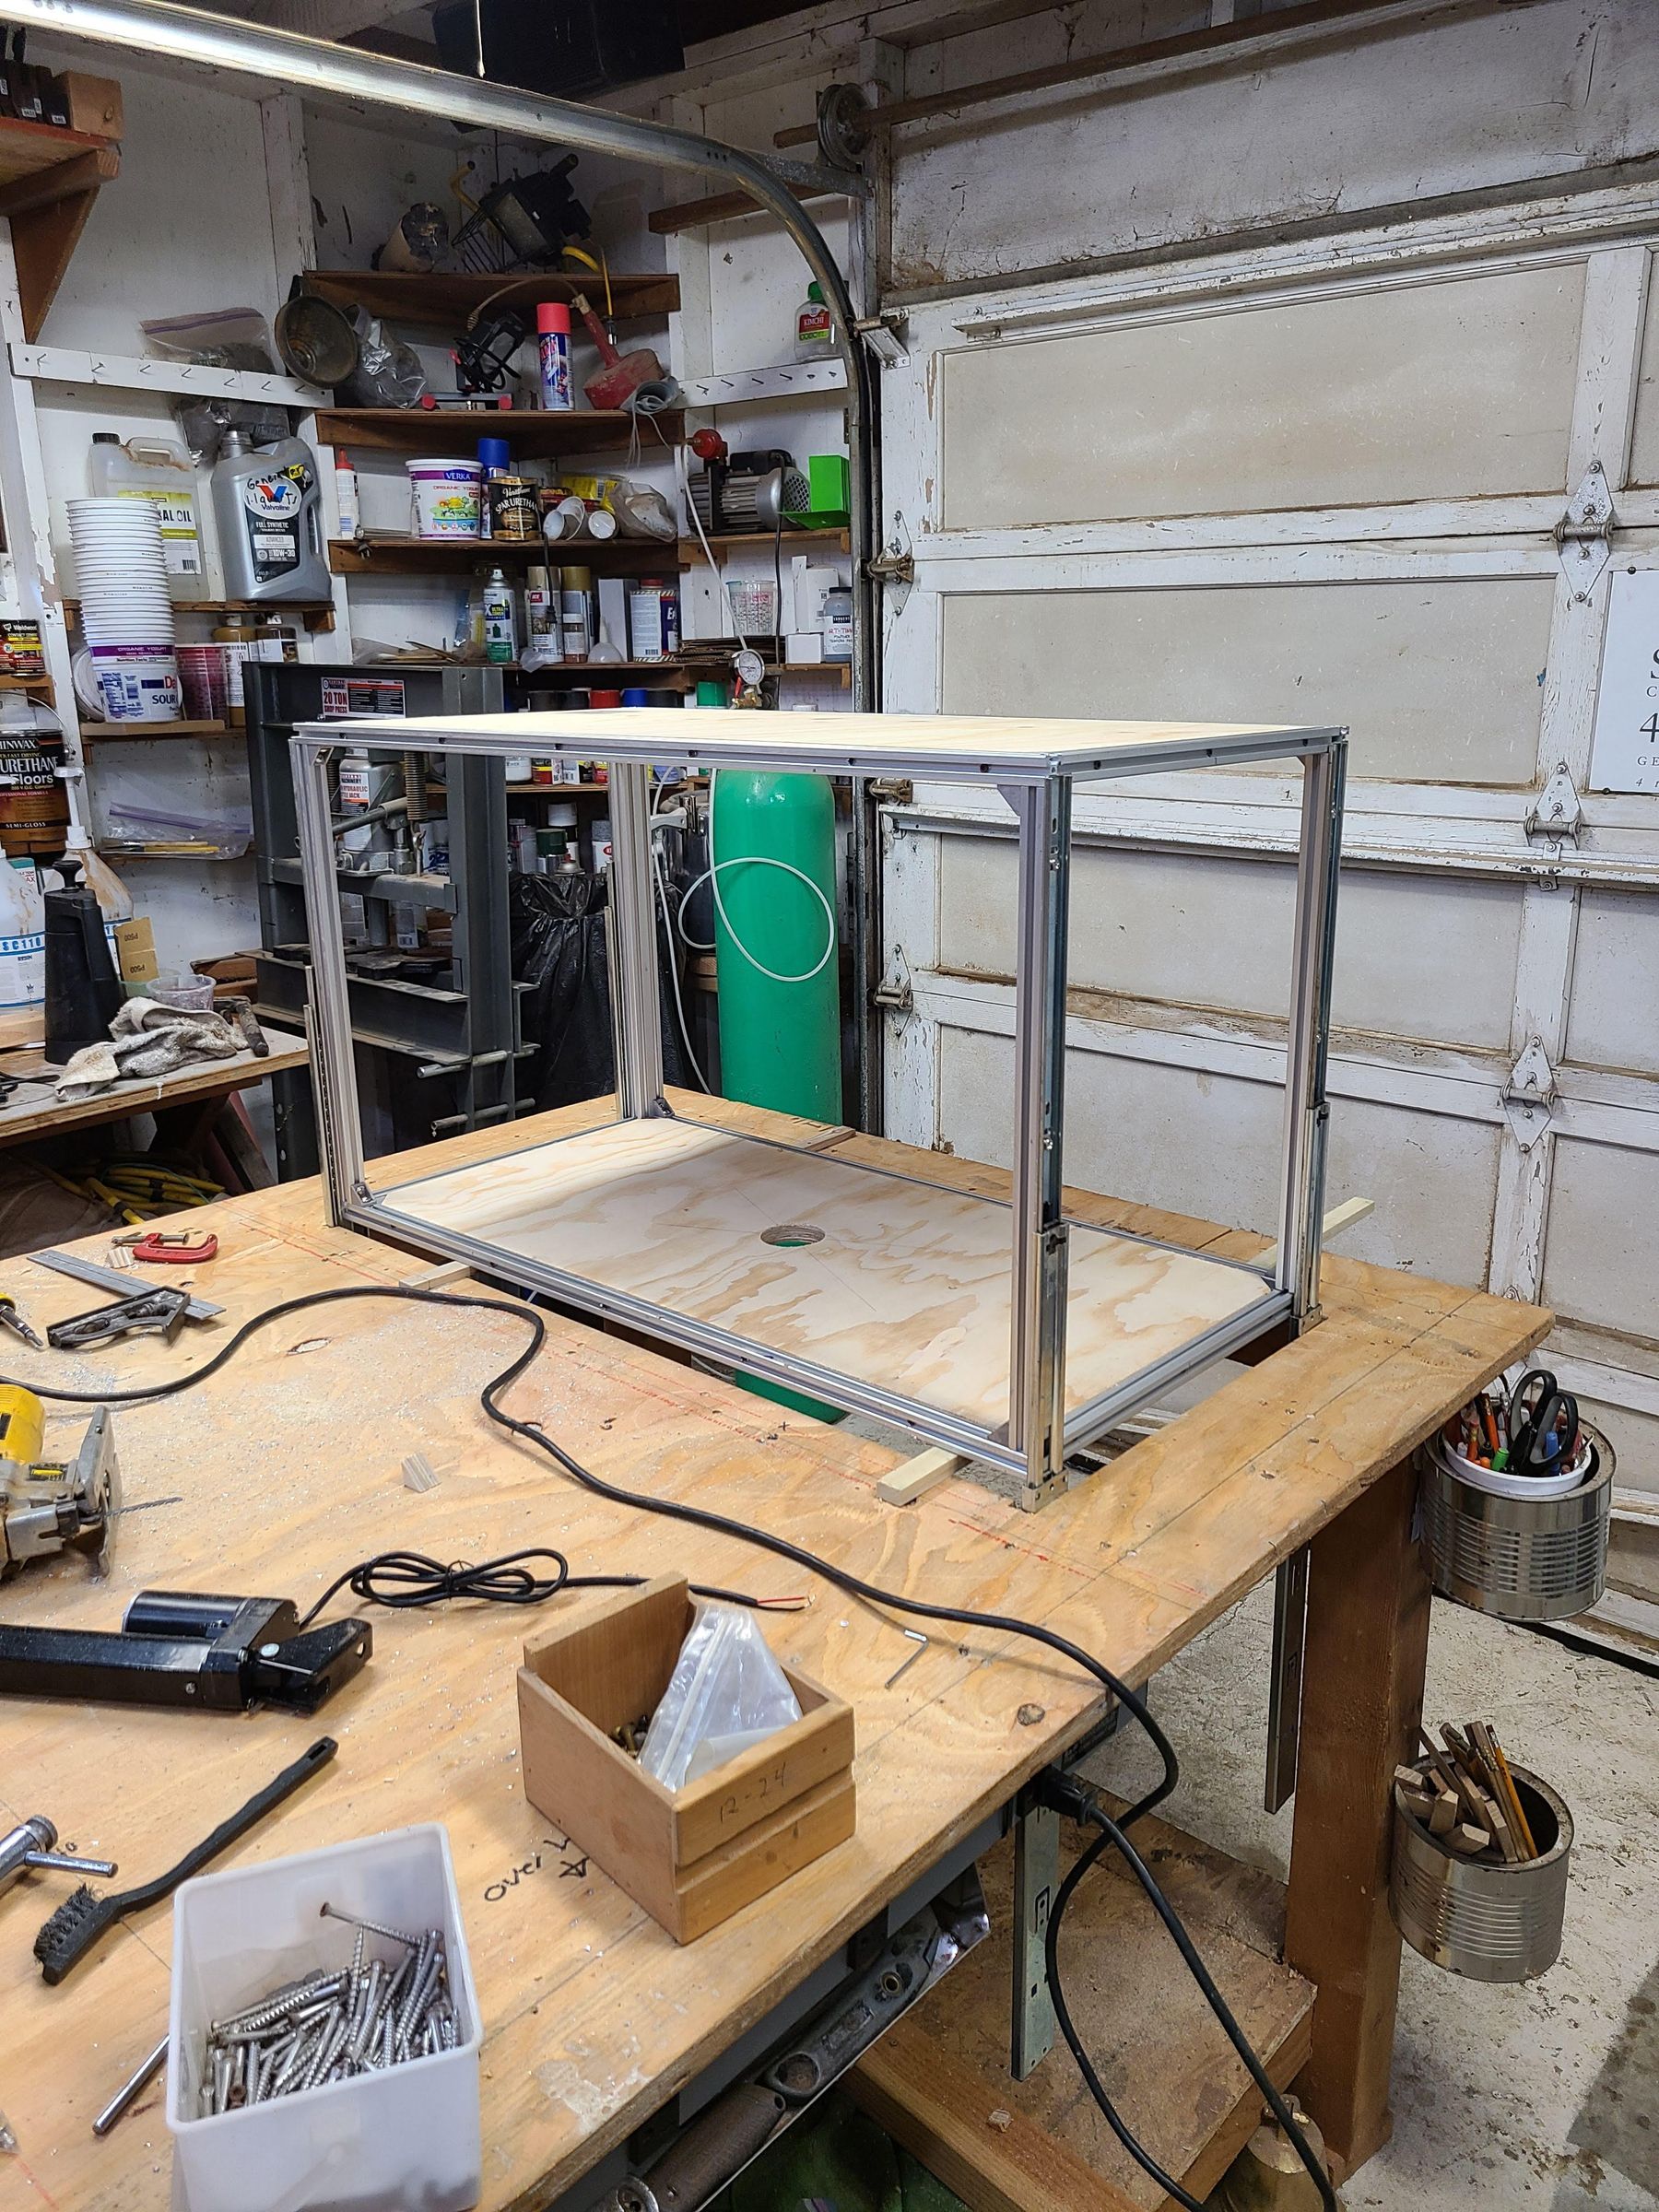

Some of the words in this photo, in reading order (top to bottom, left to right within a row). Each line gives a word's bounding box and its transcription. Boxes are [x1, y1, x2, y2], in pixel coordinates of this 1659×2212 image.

[445, 472, 471, 480] VERKA
[262, 503, 290, 512] Valvoline
[495, 500, 511, 515] SPAR
[176, 510, 192, 523] OIL
[324, 691, 333, 705] 20
[334, 691, 347, 705] TON
[0, 739, 37, 750] INWAX
[2, 936, 41, 952] SC110
